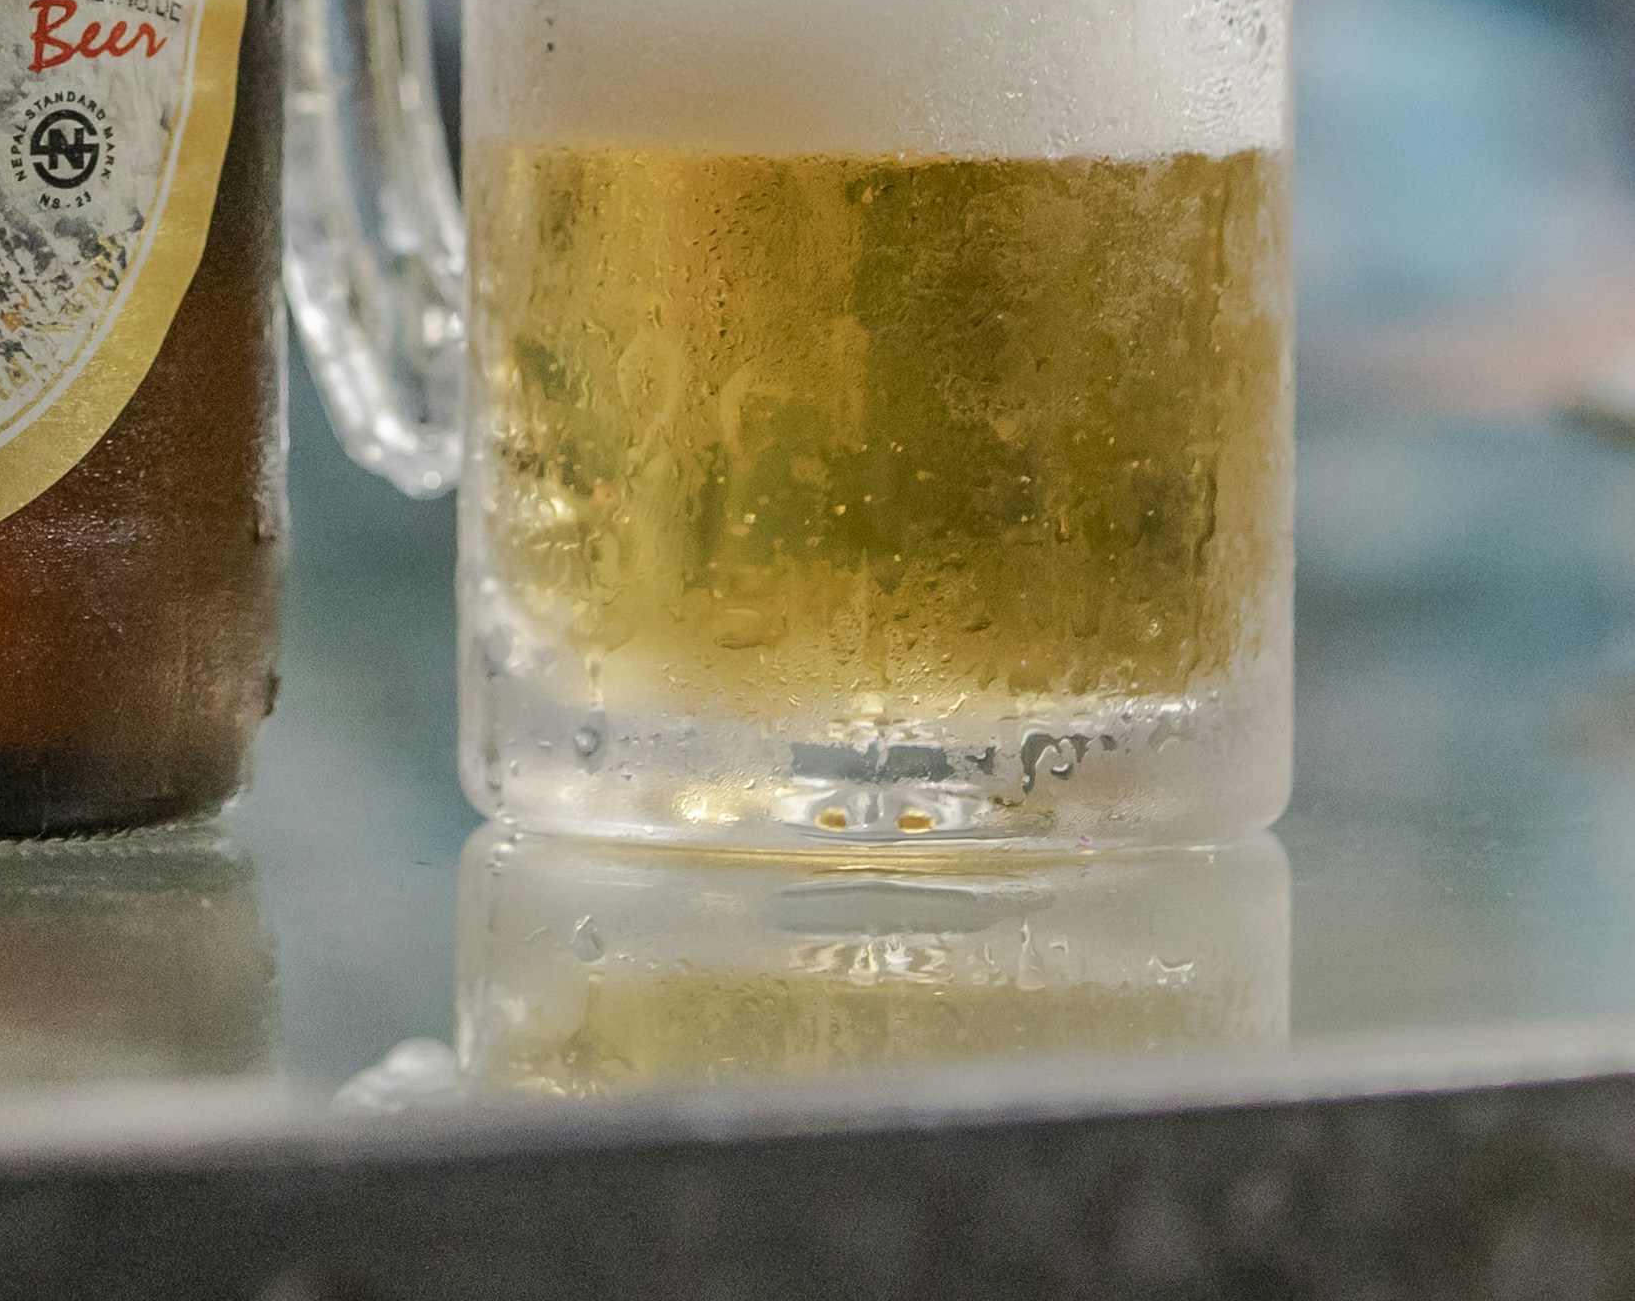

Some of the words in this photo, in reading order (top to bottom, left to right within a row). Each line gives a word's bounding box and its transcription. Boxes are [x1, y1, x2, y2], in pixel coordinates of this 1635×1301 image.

[10, 122, 28, 182] NEPAL
[24, 90, 107, 121] STANDARD
[100, 125, 116, 180] MARK
